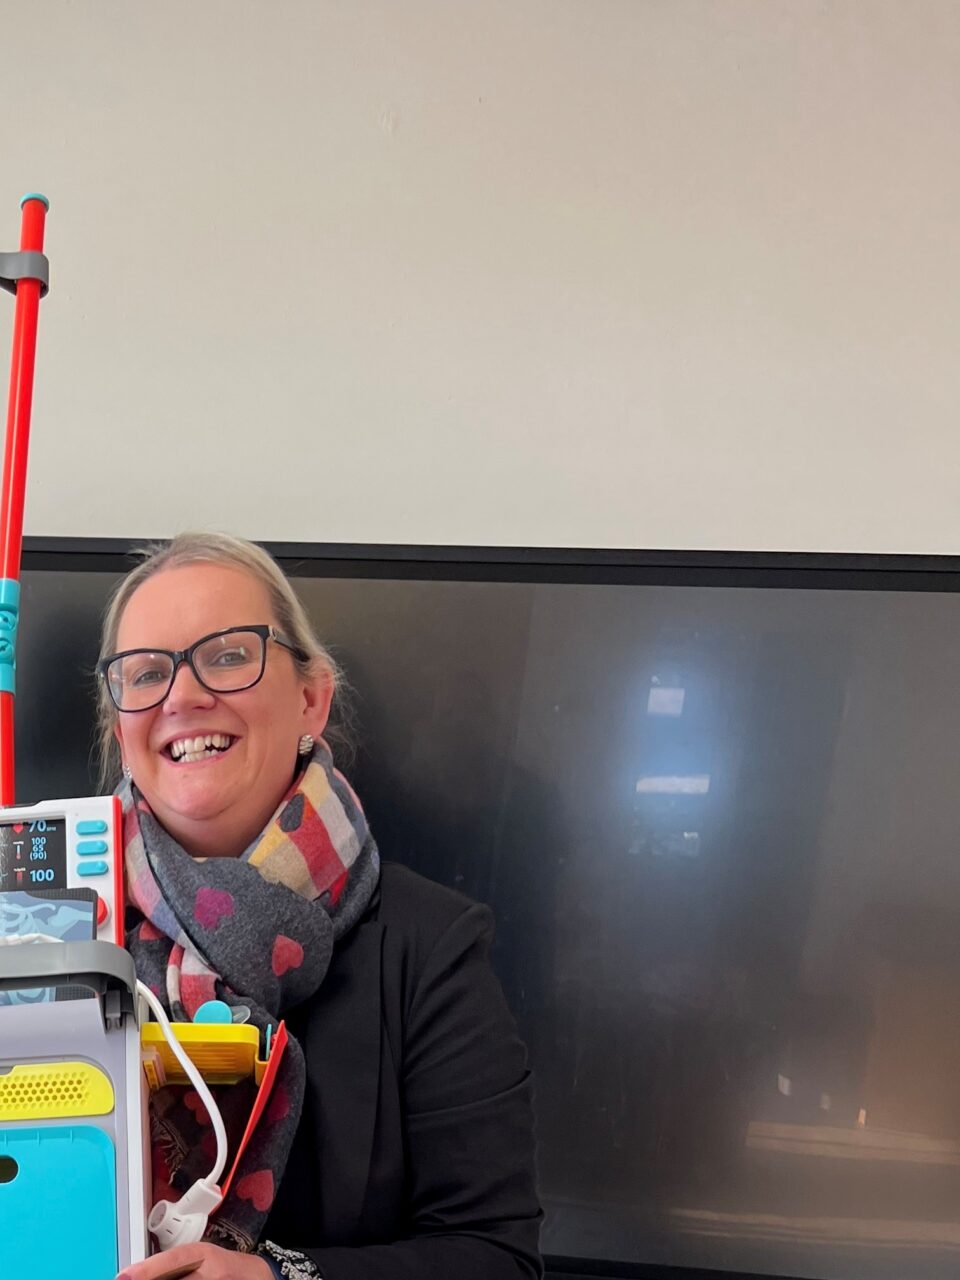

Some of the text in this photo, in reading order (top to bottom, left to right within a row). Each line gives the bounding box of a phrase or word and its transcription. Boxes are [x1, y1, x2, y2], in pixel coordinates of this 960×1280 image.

[29, 820, 47, 833] 70
[31, 837, 47, 845] 100
[32, 844, 44, 852] 65
[29, 850, 47, 861] (90)
[29, 868, 55, 882] 100
